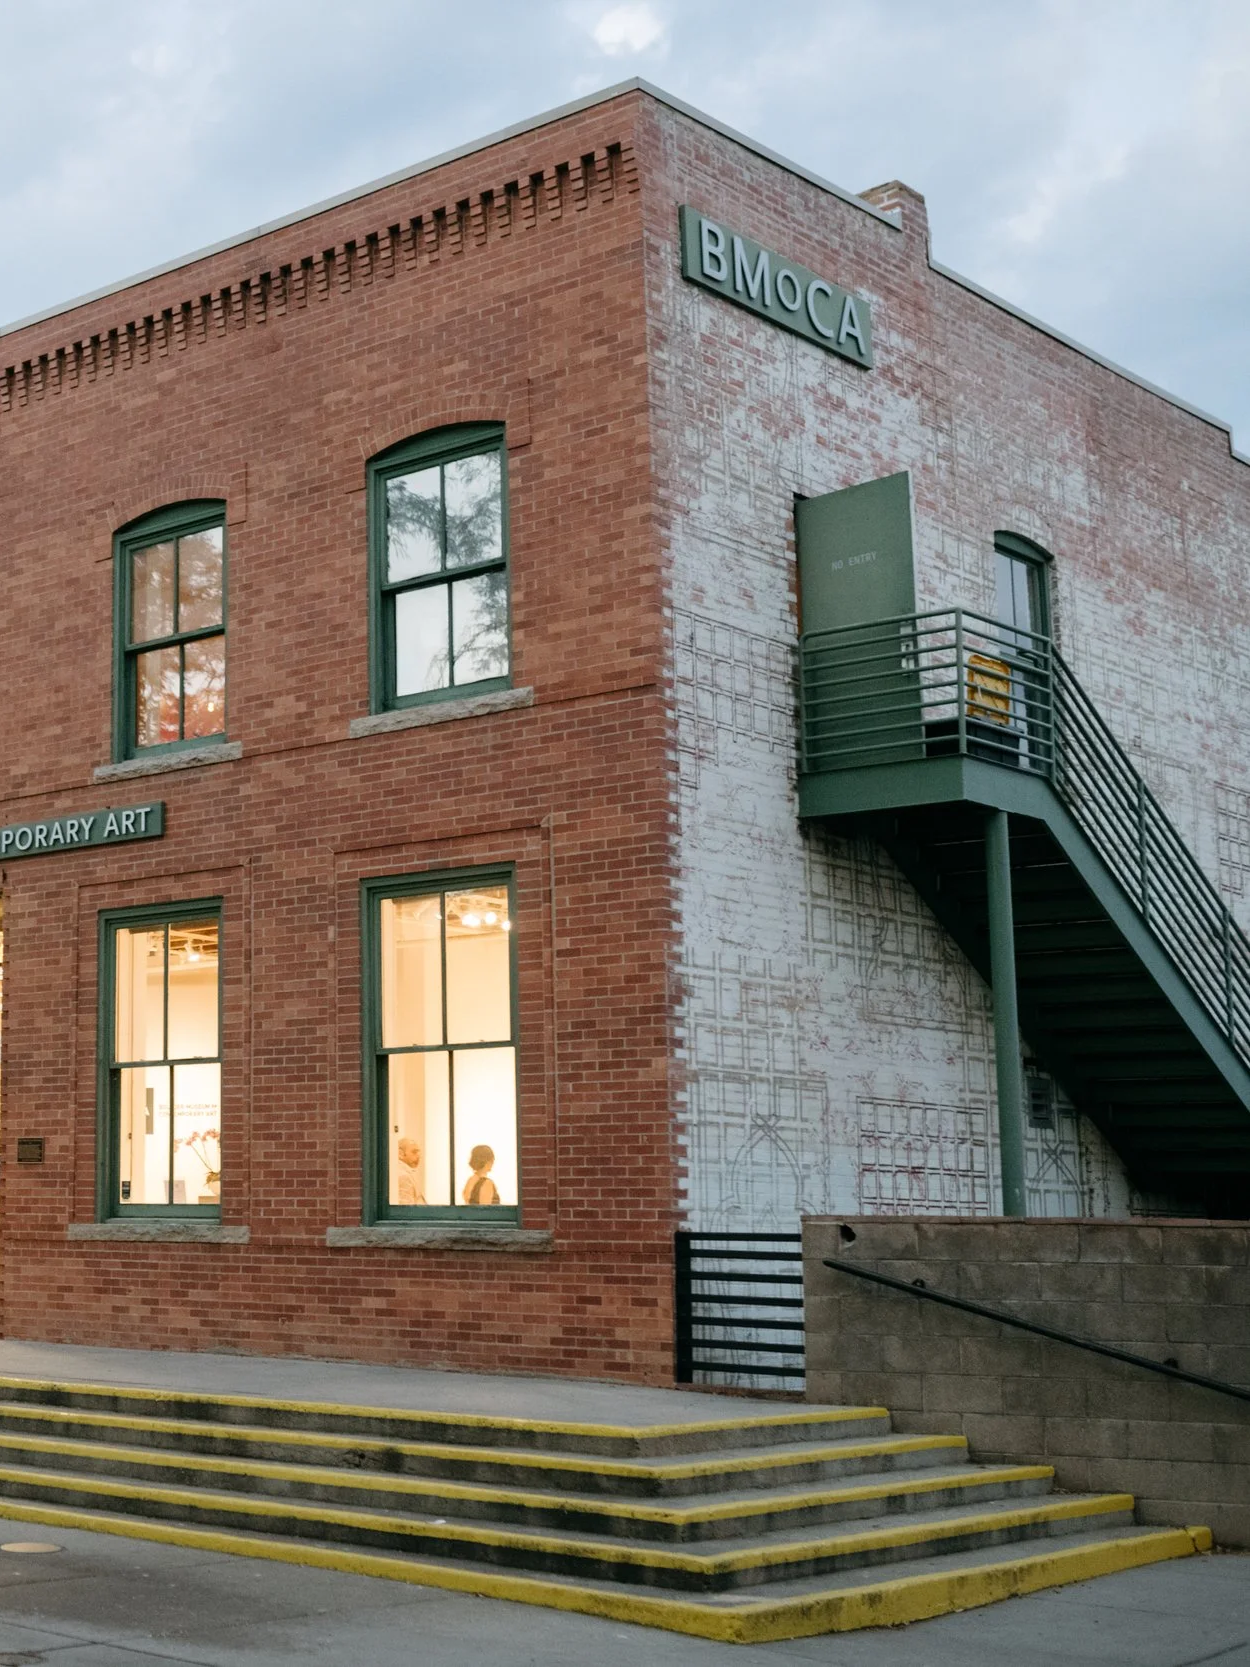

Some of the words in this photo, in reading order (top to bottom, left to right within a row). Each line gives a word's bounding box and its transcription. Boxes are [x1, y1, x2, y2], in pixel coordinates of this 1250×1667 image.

[831, 559, 843, 572] NO
[848, 551, 877, 566] ENTRY
[103, 807, 152, 838] ART
